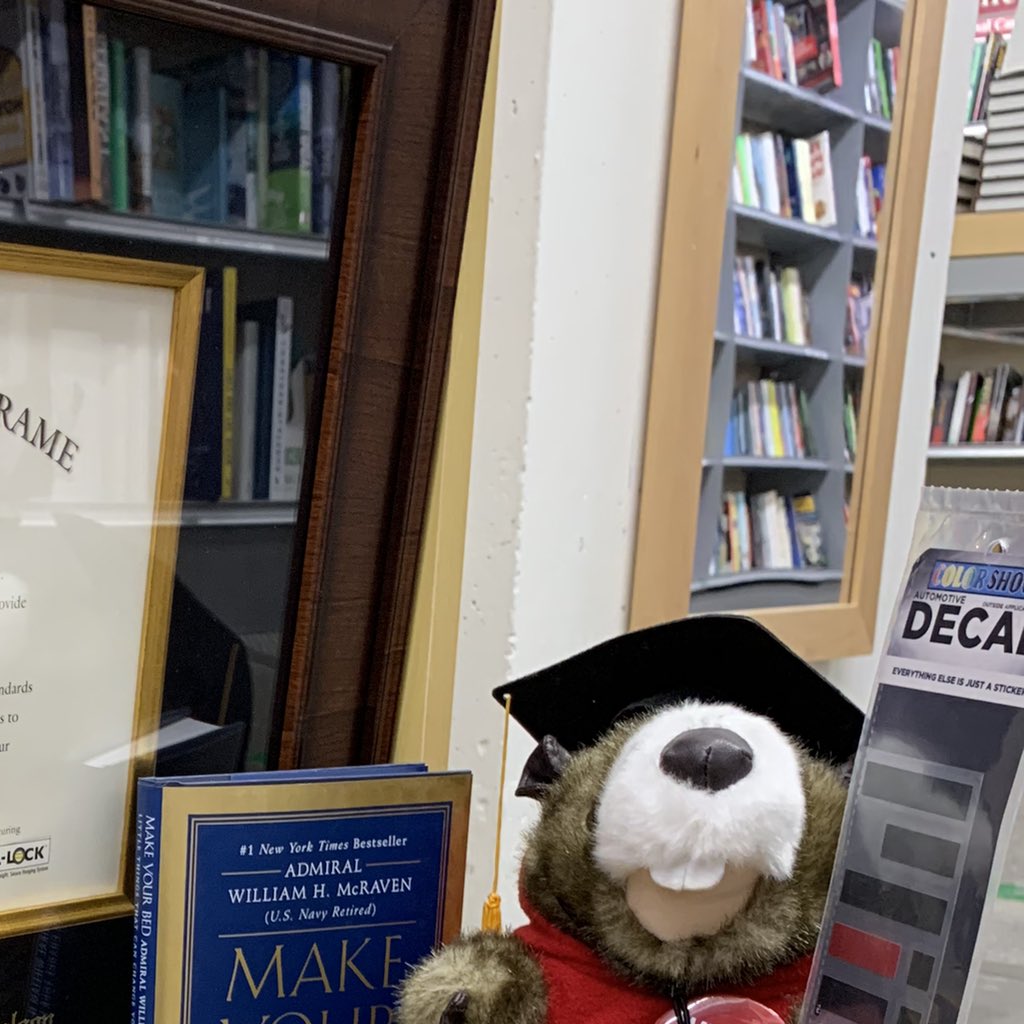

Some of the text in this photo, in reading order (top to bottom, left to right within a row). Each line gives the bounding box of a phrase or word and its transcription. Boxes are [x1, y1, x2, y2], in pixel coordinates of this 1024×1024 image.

[987, 570, 1024, 593] SHO
[914, 591, 966, 605] AUTOMOTIVE
[892, 666, 937, 682] EVERYTHING
[937, 674, 957, 685] ELSE
[957, 677, 964, 686] IS
[965, 679, 985, 689] JUST
[986, 682, 992, 690] A
[7, 713, 19, 724] to
[143, 815, 156, 858] MAKE
[239, 835, 407, 856] #1 New York Times Bestseller
[284, 858, 362, 878] ADMIRAL
[142, 863, 154, 905] YOUR
[228, 877, 412, 904] WILLIAM H. McRAVEN
[141, 910, 152, 937] BED
[264, 903, 377, 925] (U.S. Navy Retired)
[139, 939, 148, 992] ADMIRAL
[226, 935, 403, 1001] MAKE
